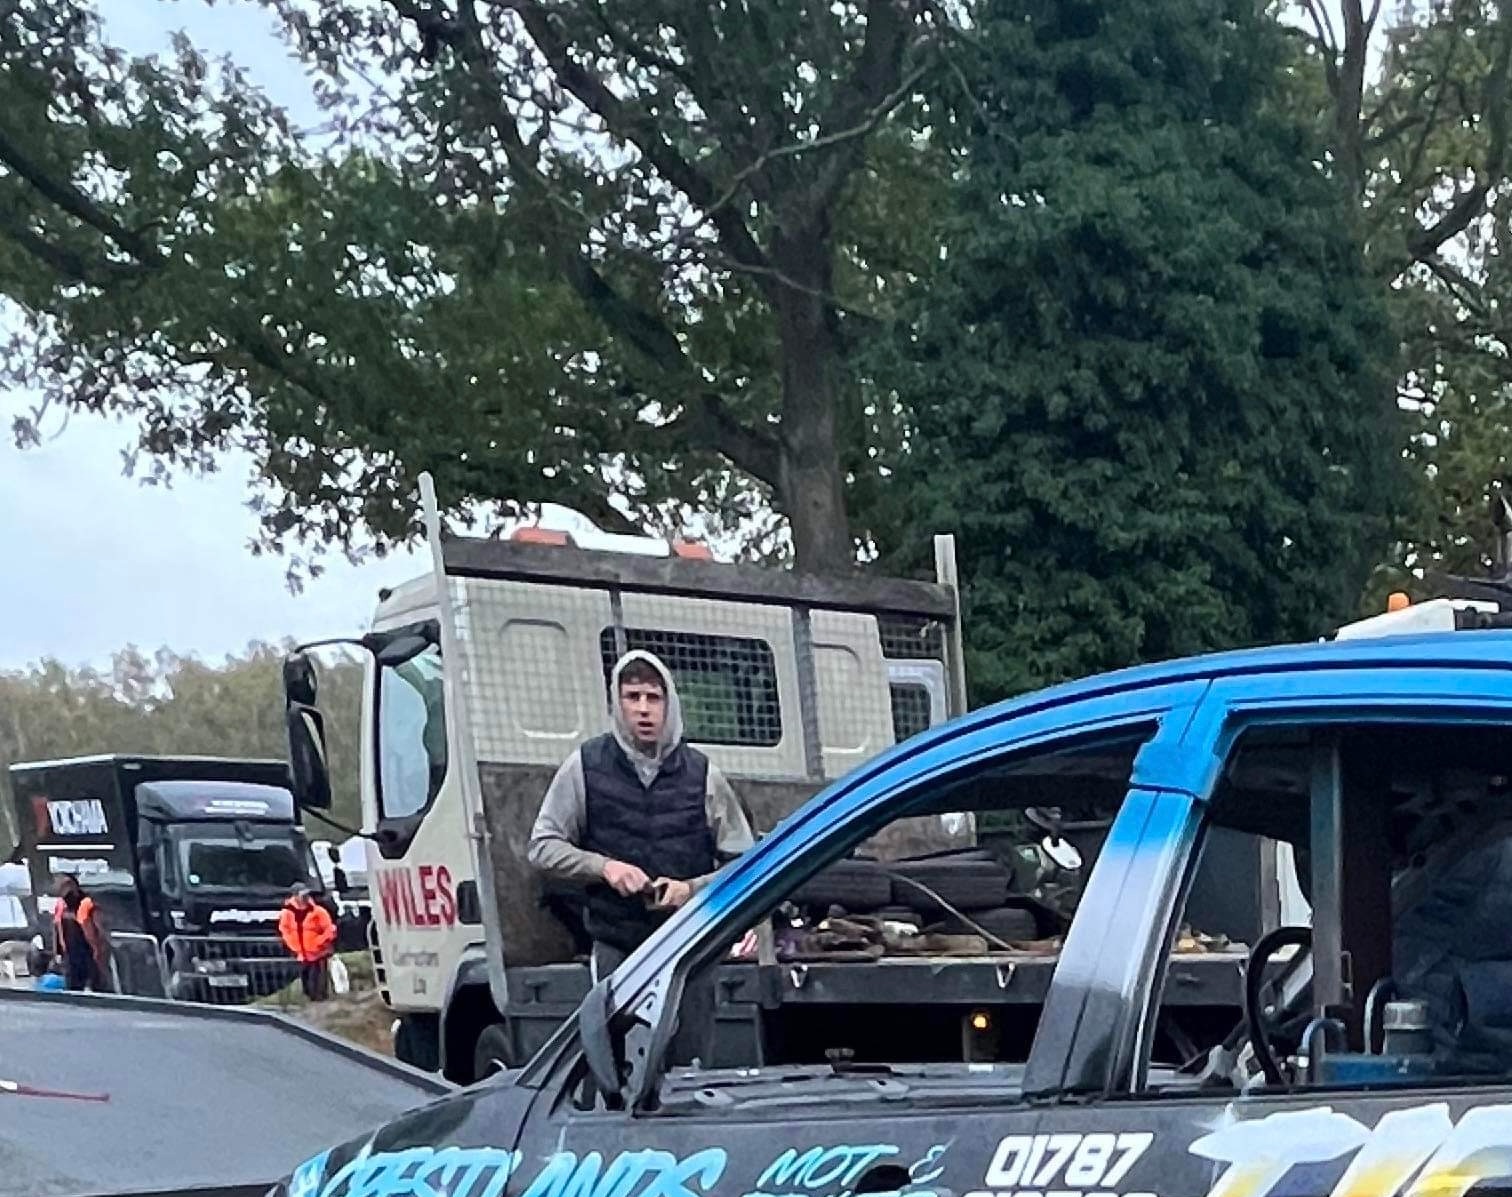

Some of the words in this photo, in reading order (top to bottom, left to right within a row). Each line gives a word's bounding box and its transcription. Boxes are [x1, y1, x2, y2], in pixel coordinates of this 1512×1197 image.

[375, 863, 457, 929] WILES
[756, 1144, 899, 1188] MOT
[985, 1132, 1154, 1187] 01787
